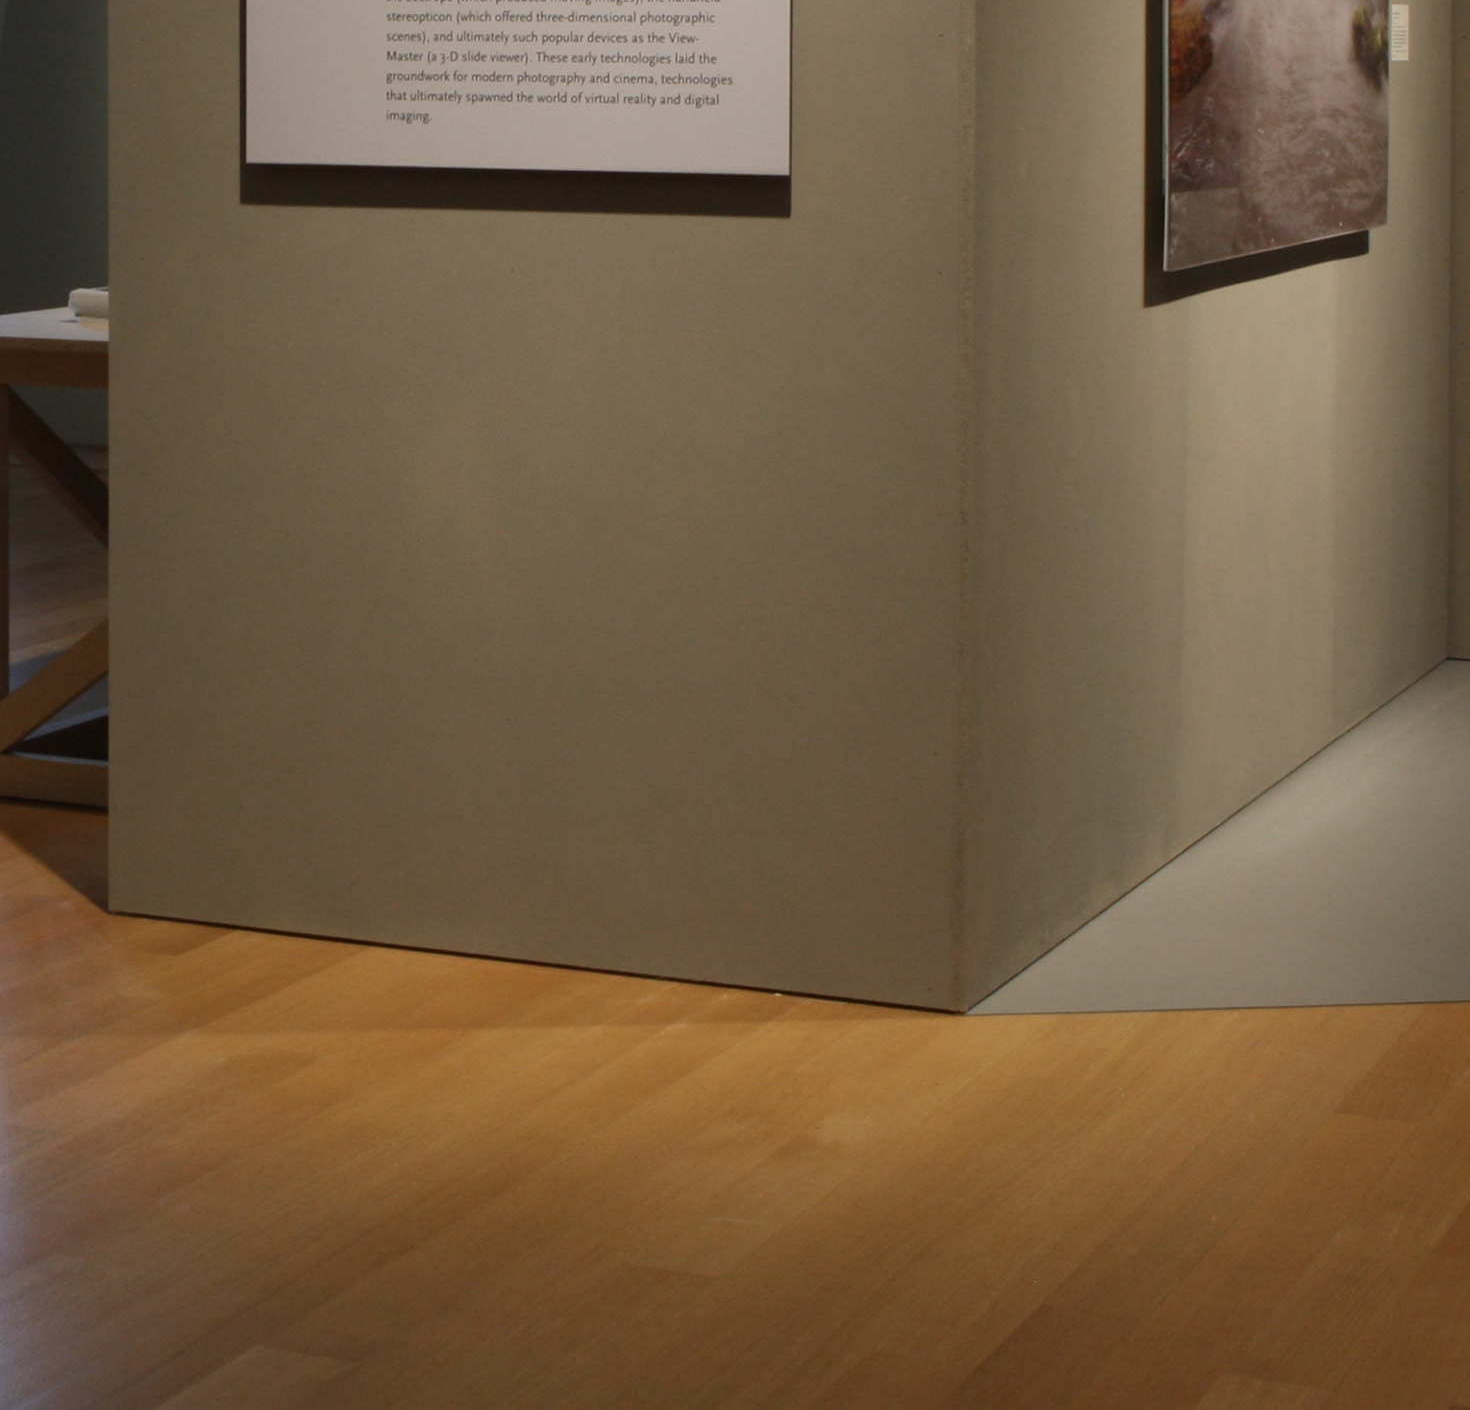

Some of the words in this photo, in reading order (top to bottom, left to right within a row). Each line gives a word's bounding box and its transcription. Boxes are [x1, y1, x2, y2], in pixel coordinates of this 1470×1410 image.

[386, 12, 452, 24] stereopticon
[456, 10, 492, 25] (which
[494, 10, 533, 22] offered
[536, 11, 636, 23] three-dimensional
[640, 11, 715, 27] photographic
[386, 31, 430, 44] scenes),
[433, 30, 453, 42] and
[456, 30, 509, 45] ultimately
[512, 31, 538, 43] such
[541, 31, 584, 45] popular
[587, 31, 628, 43] devices
[632, 35, 644, 43] as
[647, 32, 665, 43] the
[668, 32, 699, 44] View-
[386, 70, 450, 84] groundwork
[453, 70, 468, 82] for
[471, 71, 513, 82] modern
[517, 71, 586, 87] photography
[589, 72, 610, 84] and
[613, 75, 658, 85] cinema,
[661, 73, 733, 89] technologies
[386, 89, 407, 101] that
[410, 90, 462, 104] ultimately
[465, 91, 513, 105] spawned
[516, 91, 534, 103] the
[537, 91, 567, 103] world
[570, 91, 583, 104] of
[585, 92, 620, 104] virtual
[623, 93, 657, 108] reality
[660, 93, 681, 105] and
[684, 93, 719, 109] digital
[386, 110, 432, 125] imaging.
